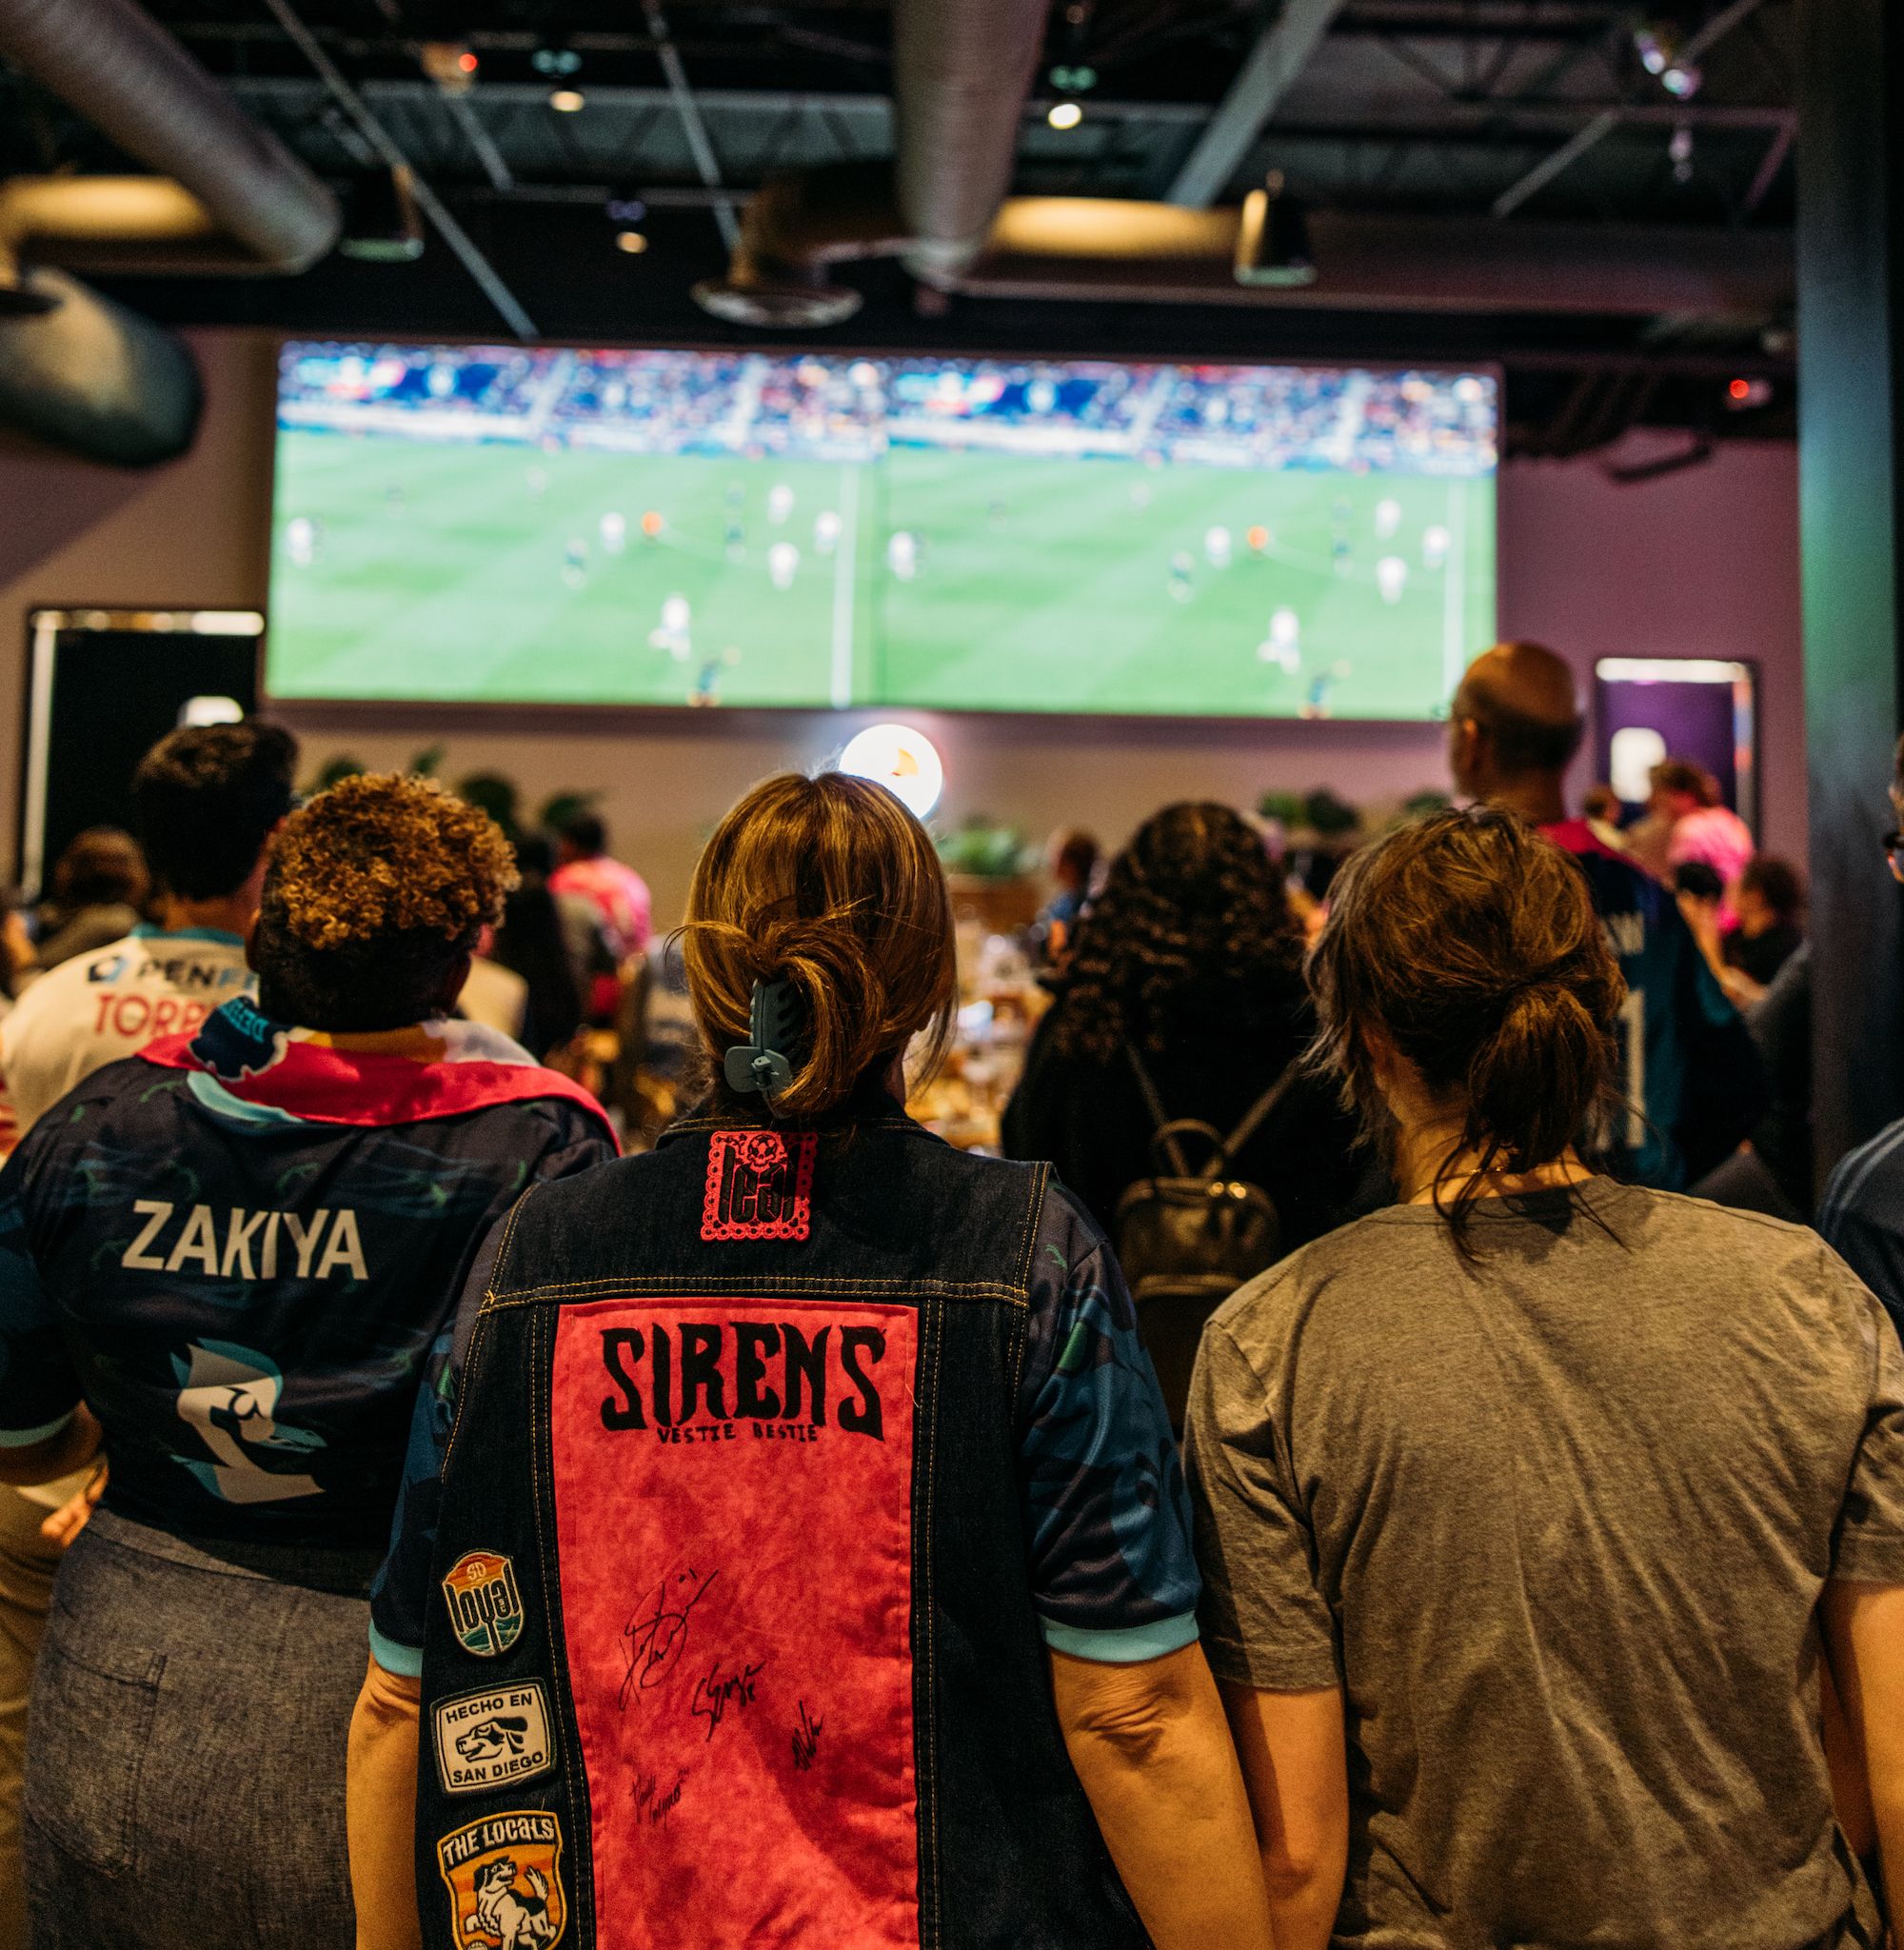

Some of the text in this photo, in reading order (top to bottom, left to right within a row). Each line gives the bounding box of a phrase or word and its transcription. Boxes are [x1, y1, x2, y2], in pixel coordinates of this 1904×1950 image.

[121, 1200, 368, 1281] ZAKIYA
[599, 1322, 887, 1443] SIRENS
[657, 1422, 818, 1444] VESTIE BESTIE
[446, 1692, 533, 1724] HECHO EN
[452, 1751, 544, 1783] SAN DIEGO
[443, 1828, 480, 1866] THE
